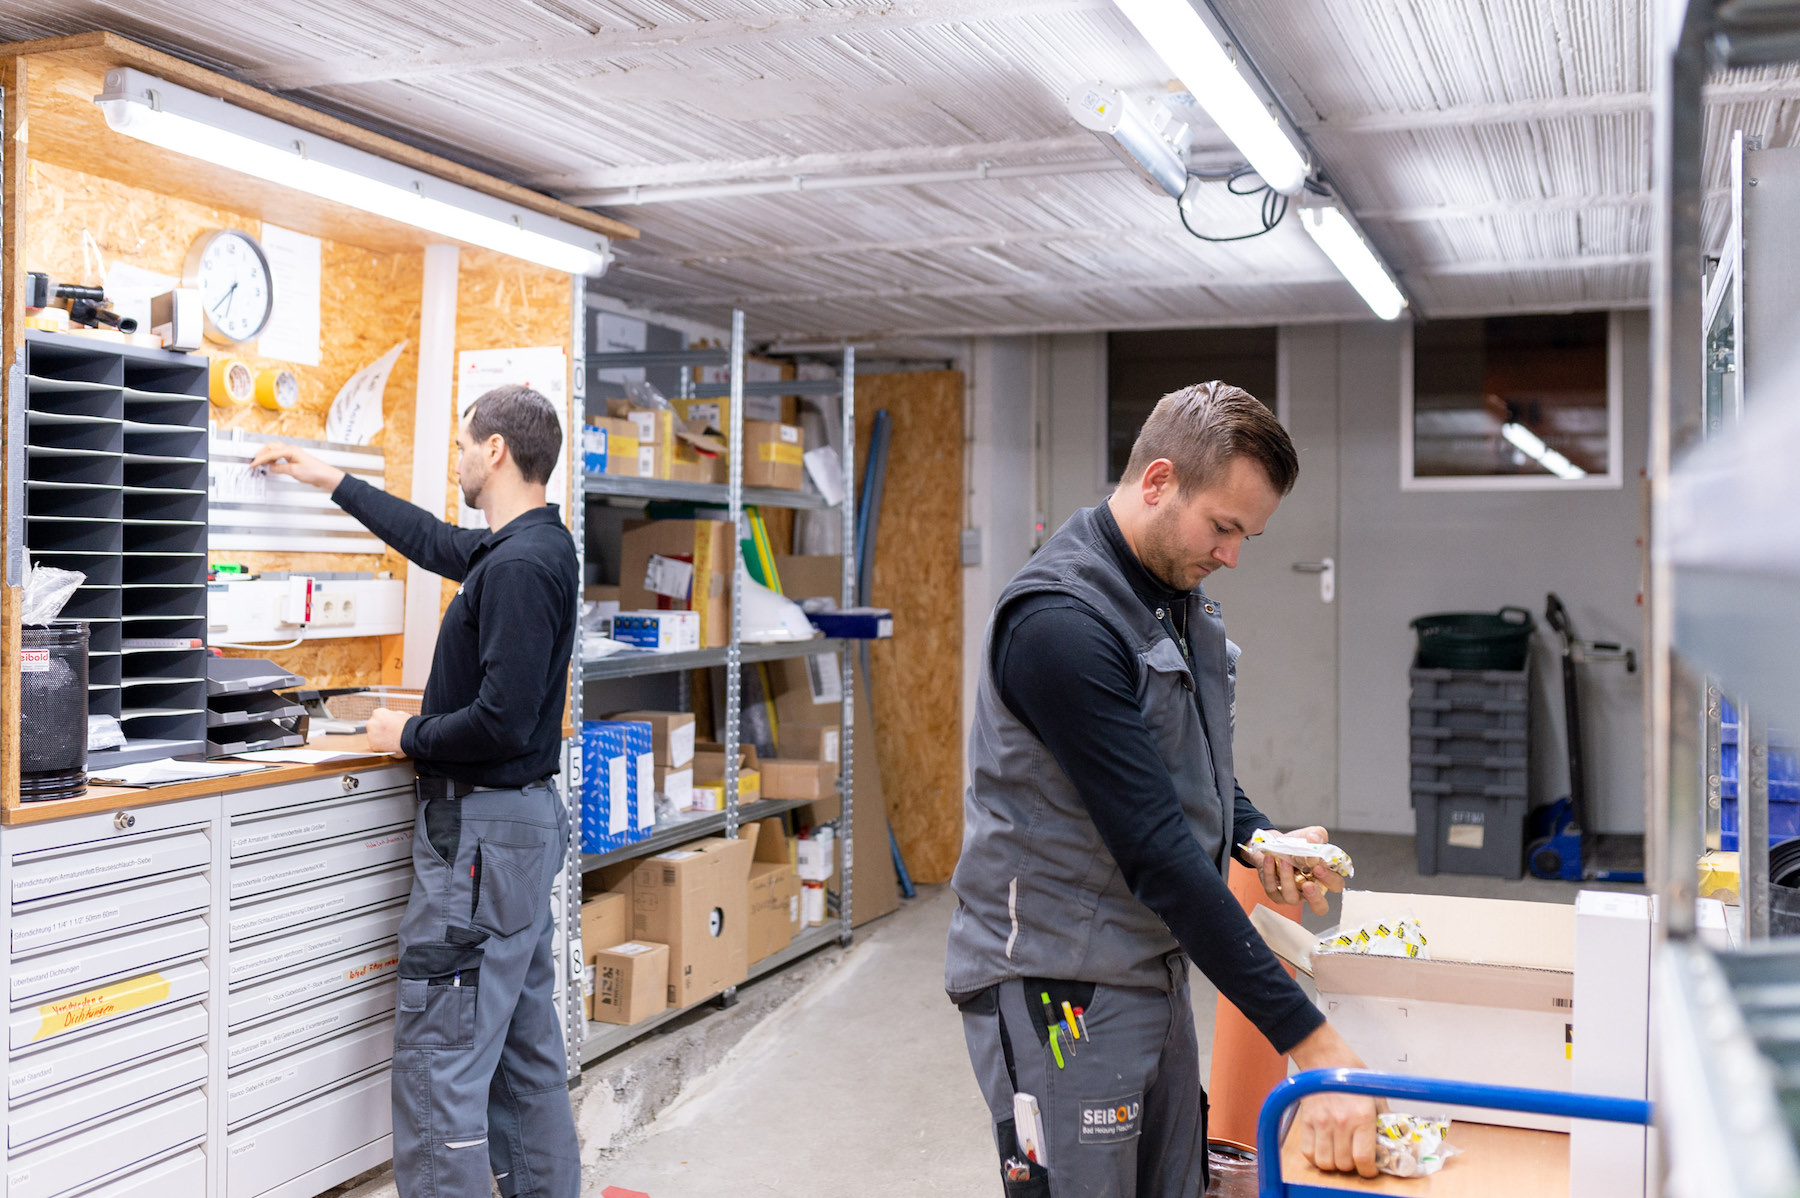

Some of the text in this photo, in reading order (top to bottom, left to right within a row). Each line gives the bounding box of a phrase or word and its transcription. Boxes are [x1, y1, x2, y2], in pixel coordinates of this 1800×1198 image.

[572, 756, 581, 781] 5
[14, 876, 59, 889] Hahndichtungen
[95, 857, 152, 873] Brauseschlauch-Siebe
[14, 925, 52, 941] Sifondichtung
[85, 912, 101, 922] 50mm
[103, 908, 118, 918] 60mm
[50, 965, 80, 979] Dichtungen
[573, 949, 582, 974] 8
[64, 1004, 114, 1027] Dichtungen
[12, 1067, 52, 1086] Ideal Standard
[1083, 1102, 1139, 1125] SEIBOLD
[1082, 1126, 1094, 1134] Bad
[1094, 1126, 1116, 1135] Heizung
